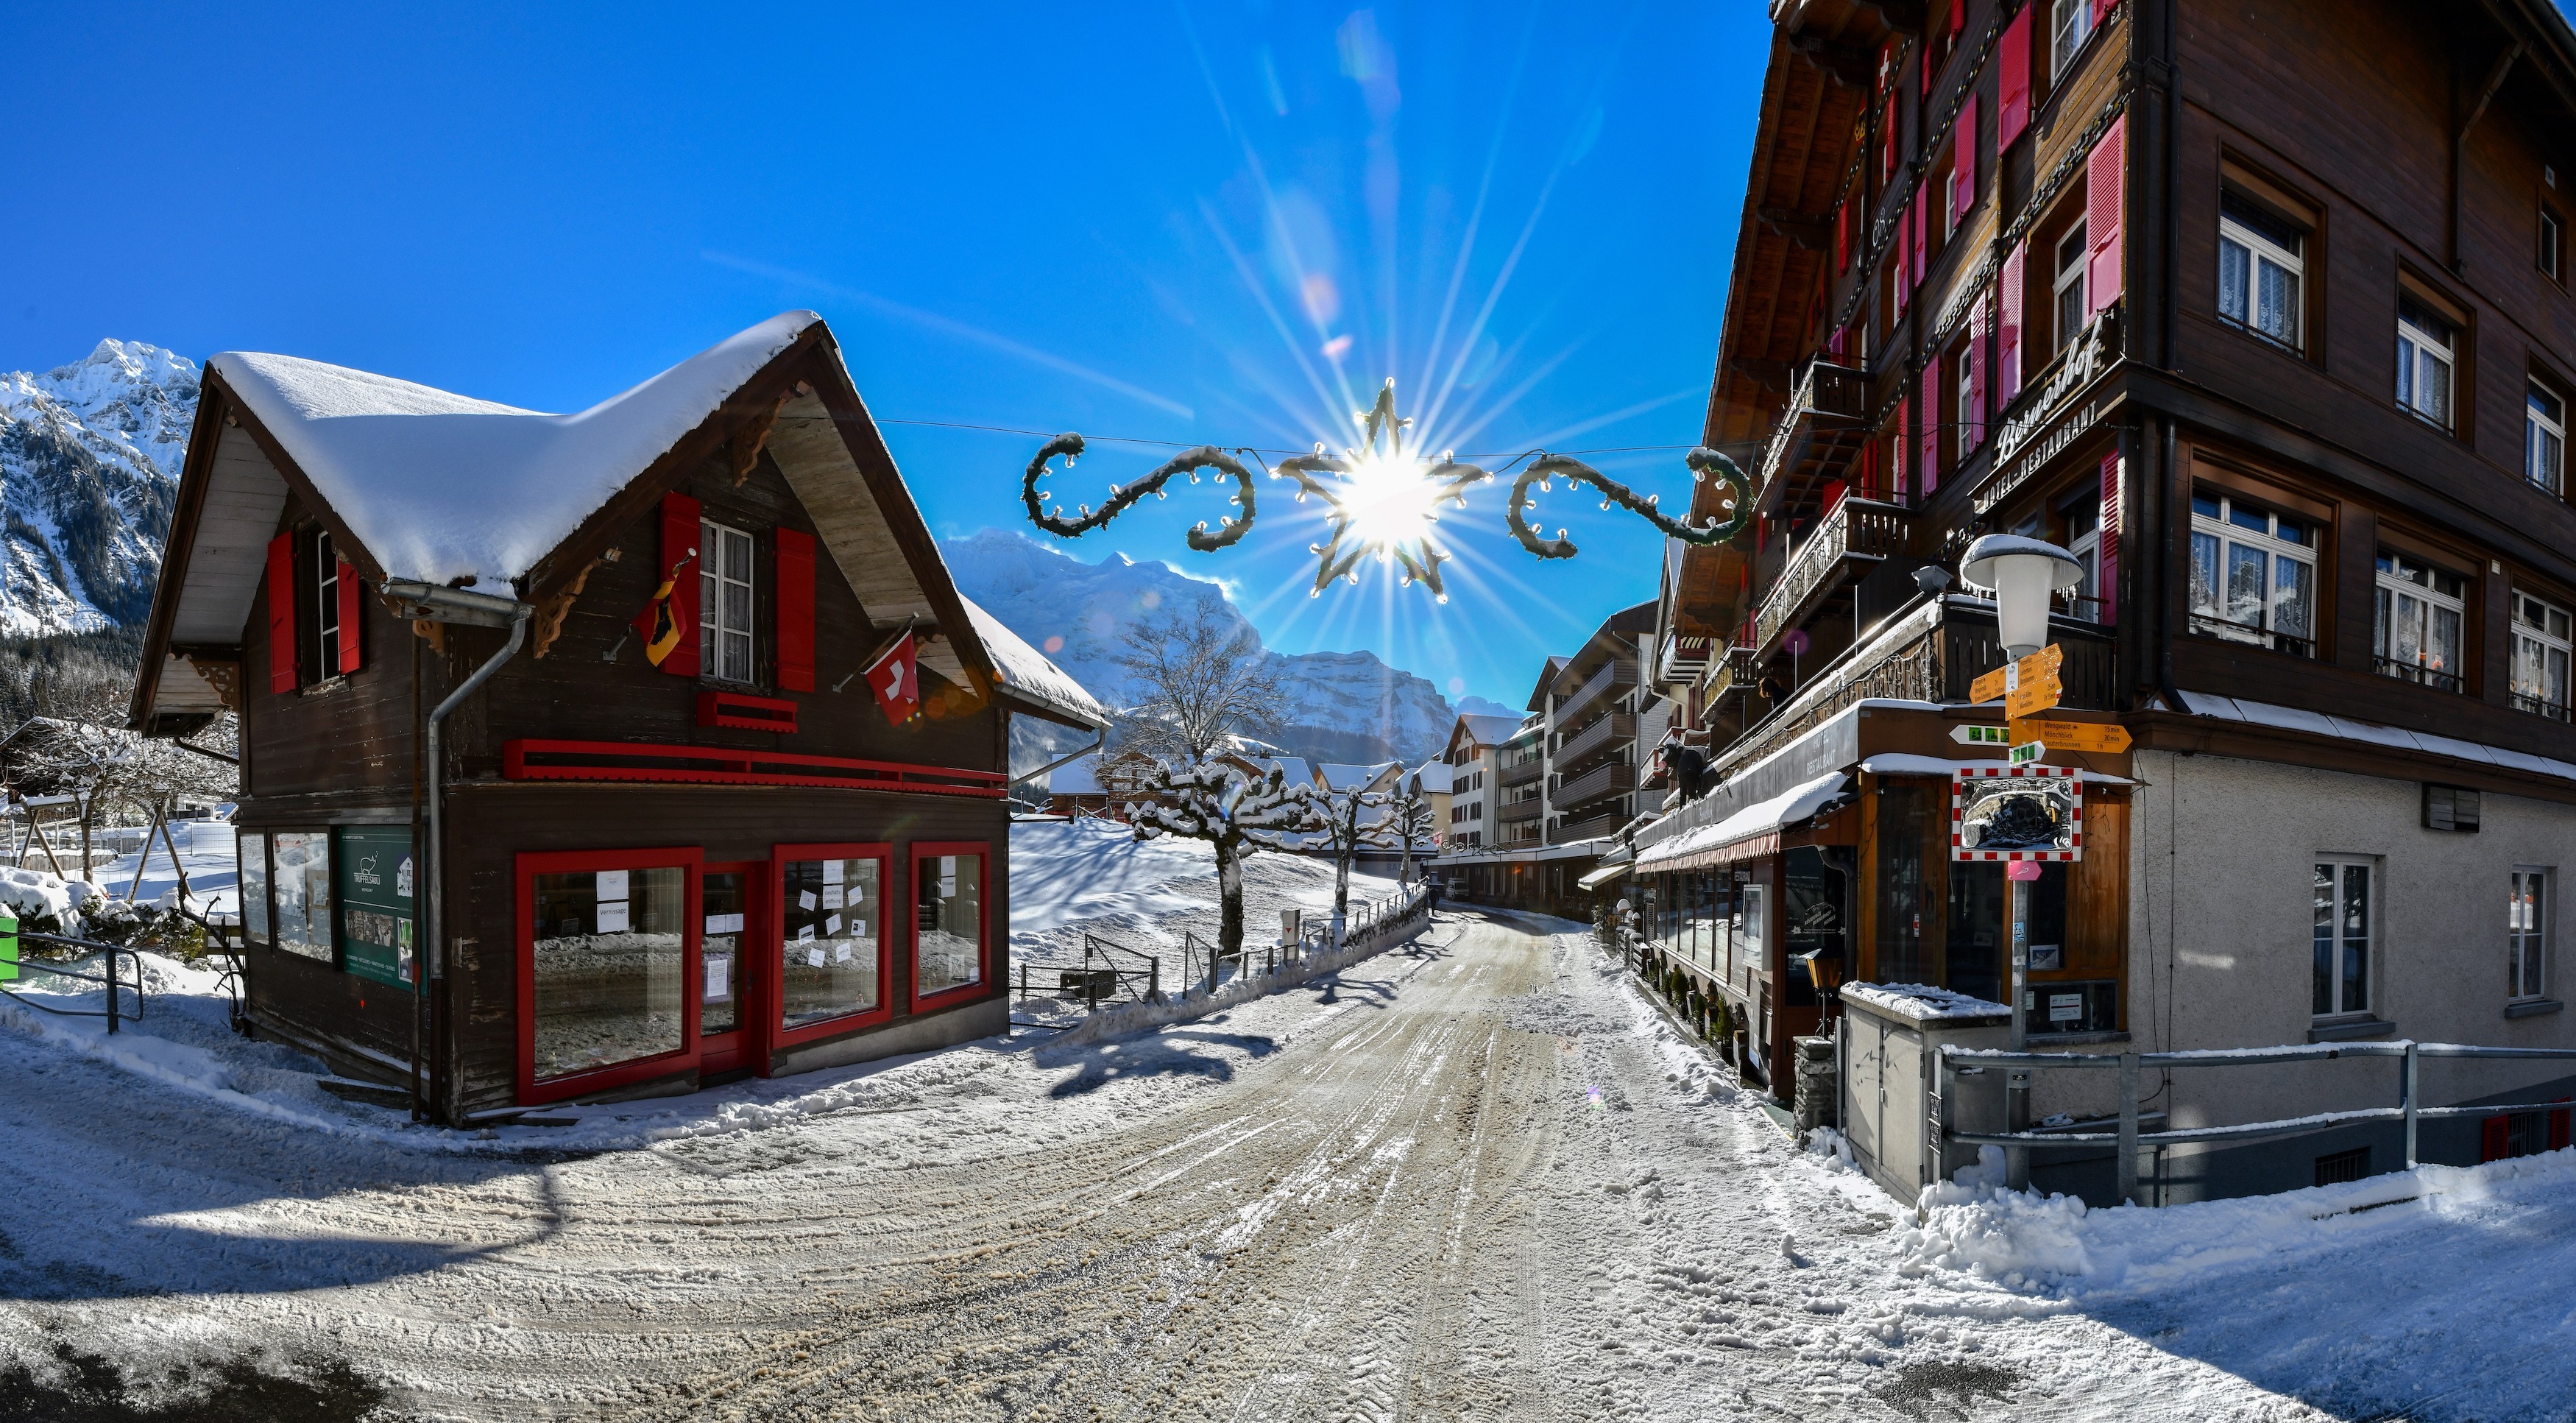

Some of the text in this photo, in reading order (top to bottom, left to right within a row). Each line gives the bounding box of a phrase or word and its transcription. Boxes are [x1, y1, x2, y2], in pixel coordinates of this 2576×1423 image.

[1997, 314, 2103, 467] Bernerhof
[1984, 473, 2013, 509] HOTEL
[2021, 400, 2097, 479] RESTAURANT
[2045, 721, 2071, 730] Wengwald
[2045, 730, 2073, 739] Mönchblick
[2044, 740, 2081, 748] Lauterbrunnen
[1806, 749, 1836, 776] RESTAURANT
[600, 908, 626, 916] Vernissage
